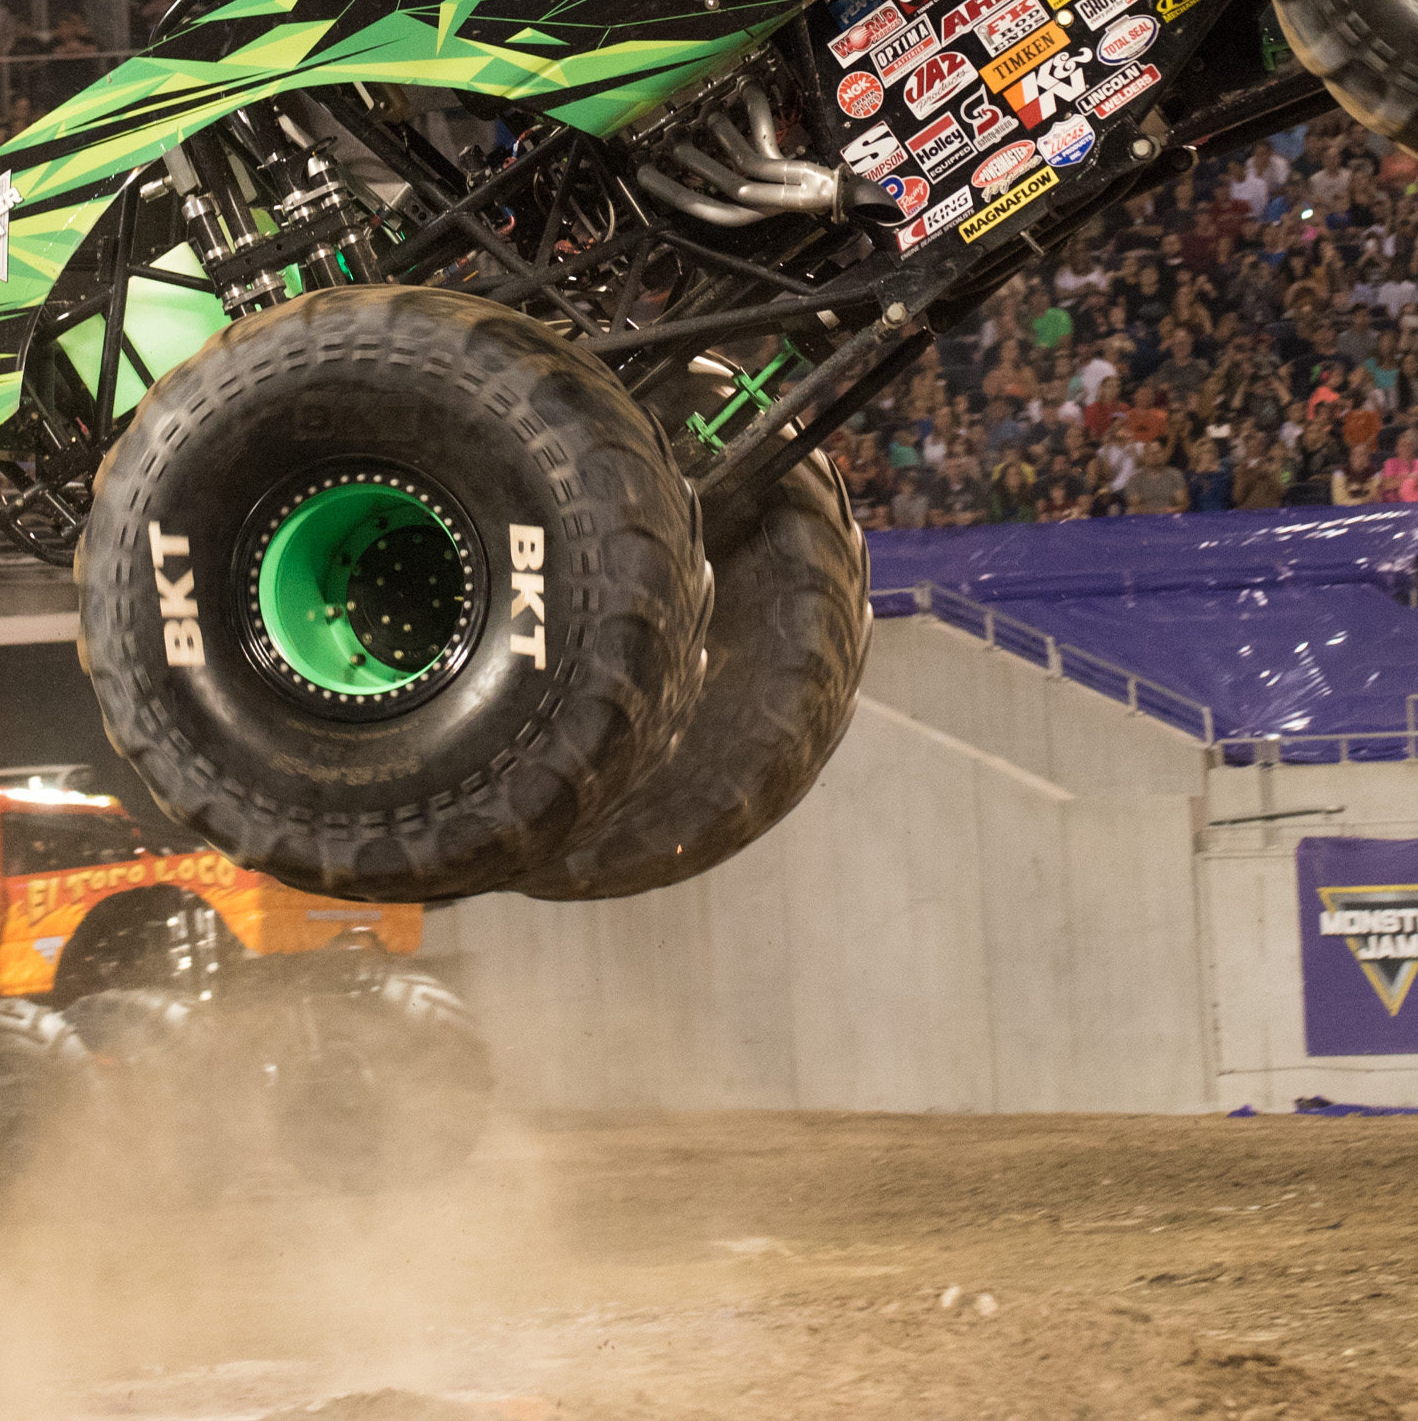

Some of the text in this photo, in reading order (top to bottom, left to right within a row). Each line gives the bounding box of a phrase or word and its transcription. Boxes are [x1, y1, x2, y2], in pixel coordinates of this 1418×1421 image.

[993, 15, 1045, 55] ENDS
[999, 9, 1041, 39] ROD
[1103, 21, 1152, 57] TOTAL SEAL
[876, 23, 930, 67] OPTIMA
[893, 44, 926, 70] BATTERIES
[992, 31, 1056, 81] TIMKEN
[842, 76, 872, 103] NGK
[851, 87, 877, 110] SPARK
[905, 53, 967, 105] JAZ
[1021, 47, 1093, 120] K&N
[1080, 65, 1141, 112] LINCOLN
[1100, 74, 1153, 113] WELDERS
[854, 93, 881, 116] PLUGS
[916, 128, 965, 165] Holley
[1050, 123, 1085, 156] LUCAS
[1050, 133, 1094, 165] OIL PRODUCTS
[1069, 150, 1082, 161] INC
[928, 145, 972, 179] EQUIPPED
[979, 145, 1029, 184] POWERMASTER
[900, 180, 925, 211] Racing
[926, 190, 970, 230] KING
[962, 170, 1053, 240] MAGNAFLOW
[900, 208, 976, 262] ENGINE BEARING SPECIALISTS
[148, 521, 206, 669] BKT
[509, 523, 546, 671] BKT
